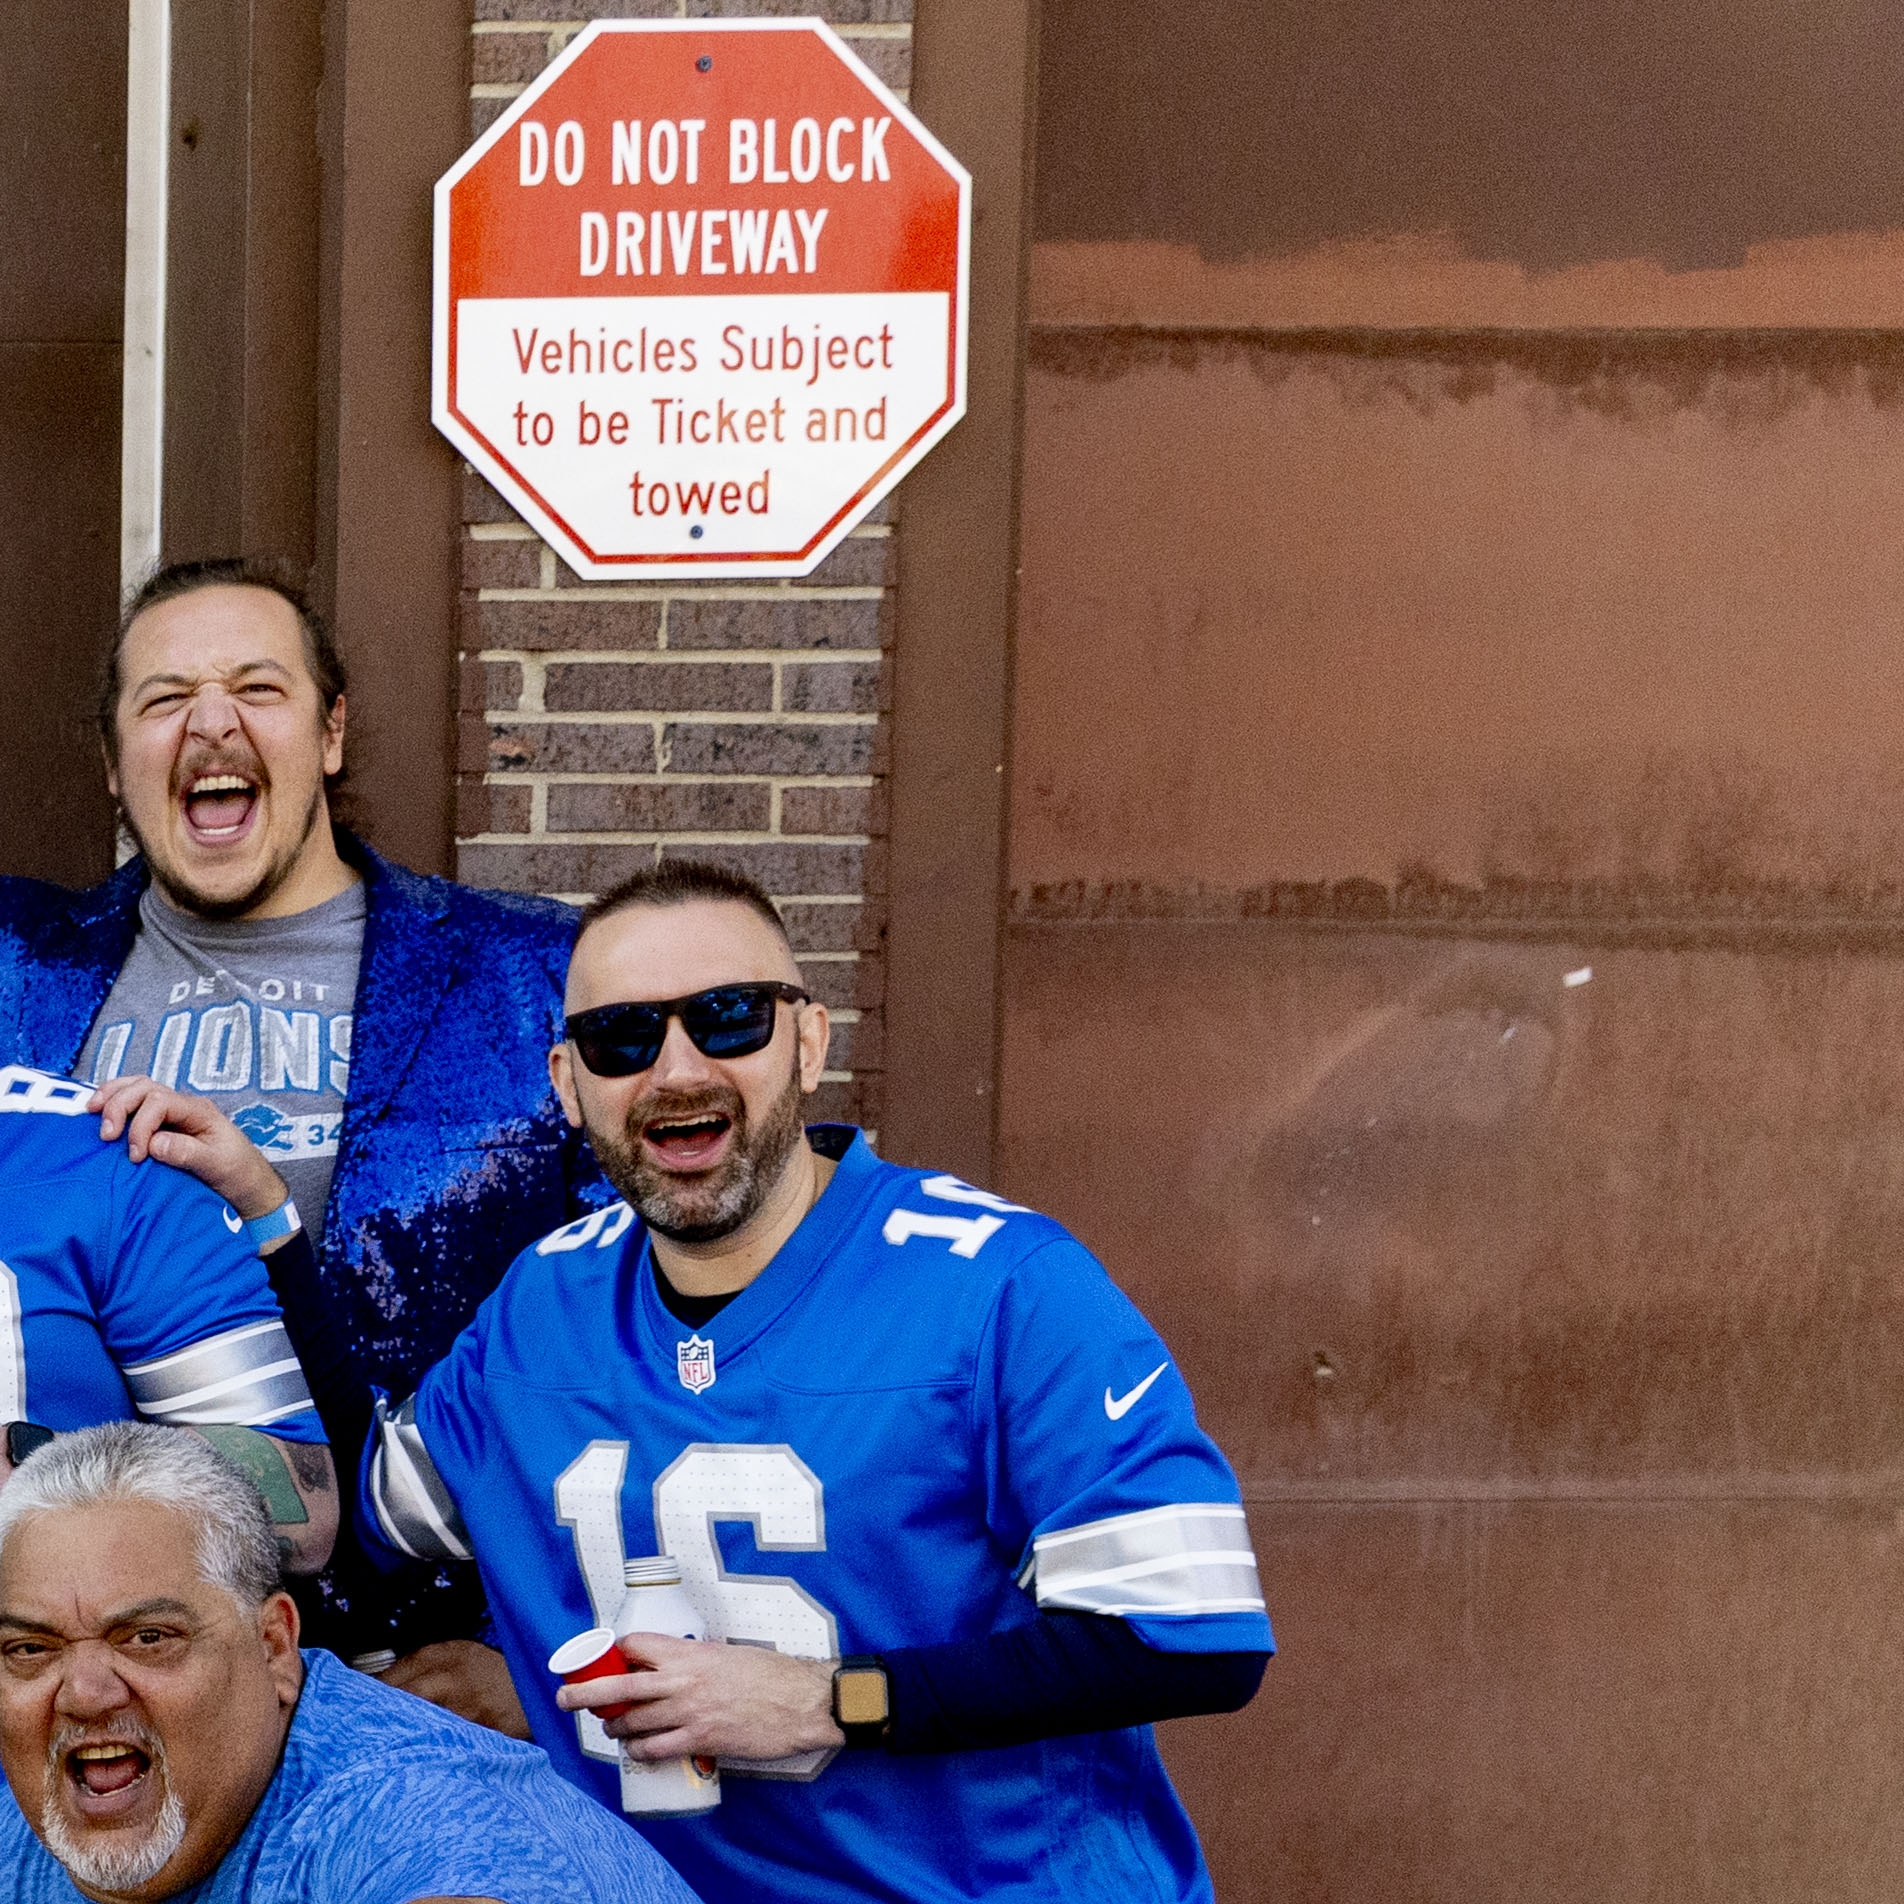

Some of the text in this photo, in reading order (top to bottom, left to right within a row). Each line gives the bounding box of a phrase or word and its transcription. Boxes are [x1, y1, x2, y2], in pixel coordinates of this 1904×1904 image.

[520, 116, 891, 186] DO NOT BLOCK
[580, 208, 829, 276] DRIVEWAY
[513, 324, 893, 385] Vehicles Subject
[514, 397, 886, 445] to be Ticket and
[630, 471, 770, 517] towed
[683, 1362, 708, 1383] NFL
[554, 1439, 840, 1782] 16
